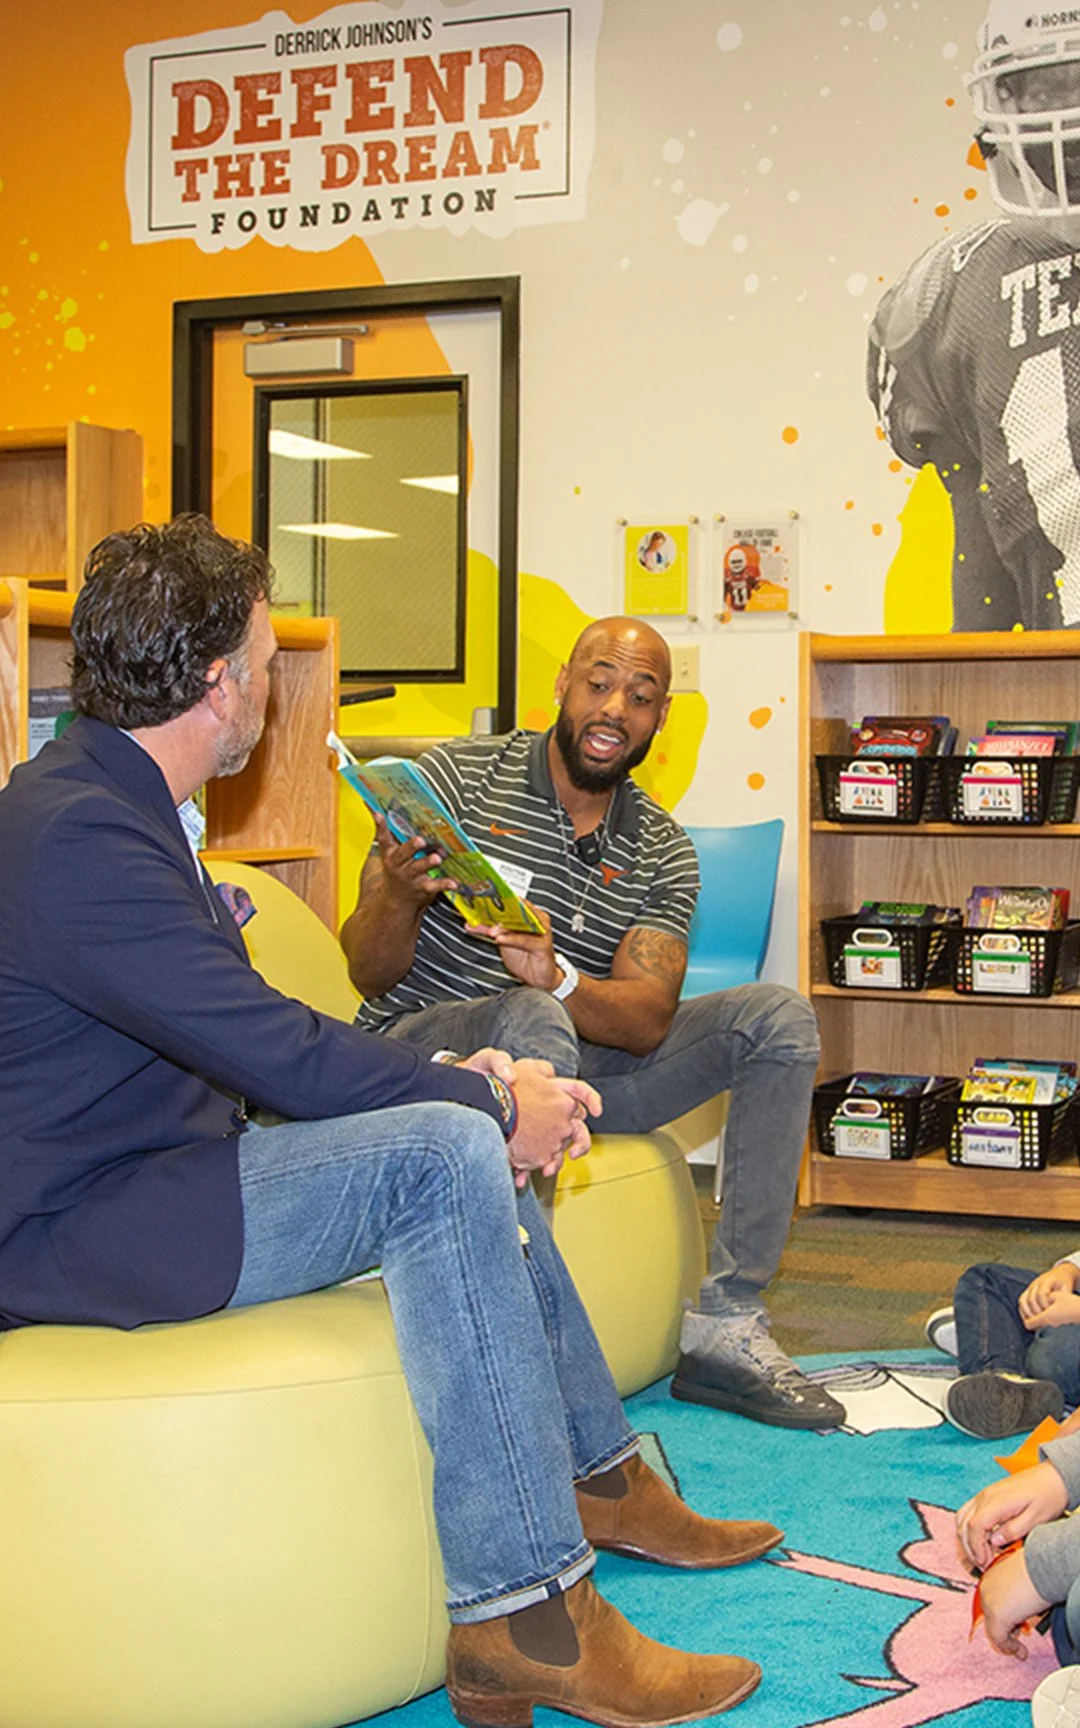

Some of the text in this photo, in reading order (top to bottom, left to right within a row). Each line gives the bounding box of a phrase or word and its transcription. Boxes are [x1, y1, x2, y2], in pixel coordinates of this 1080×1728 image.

[275, 16, 433, 57] DERRICK JOHNSON'S
[171, 43, 544, 151] DEFEND
[174, 124, 541, 203] THE DREAM
[210, 188, 498, 235] FOUNDATION
